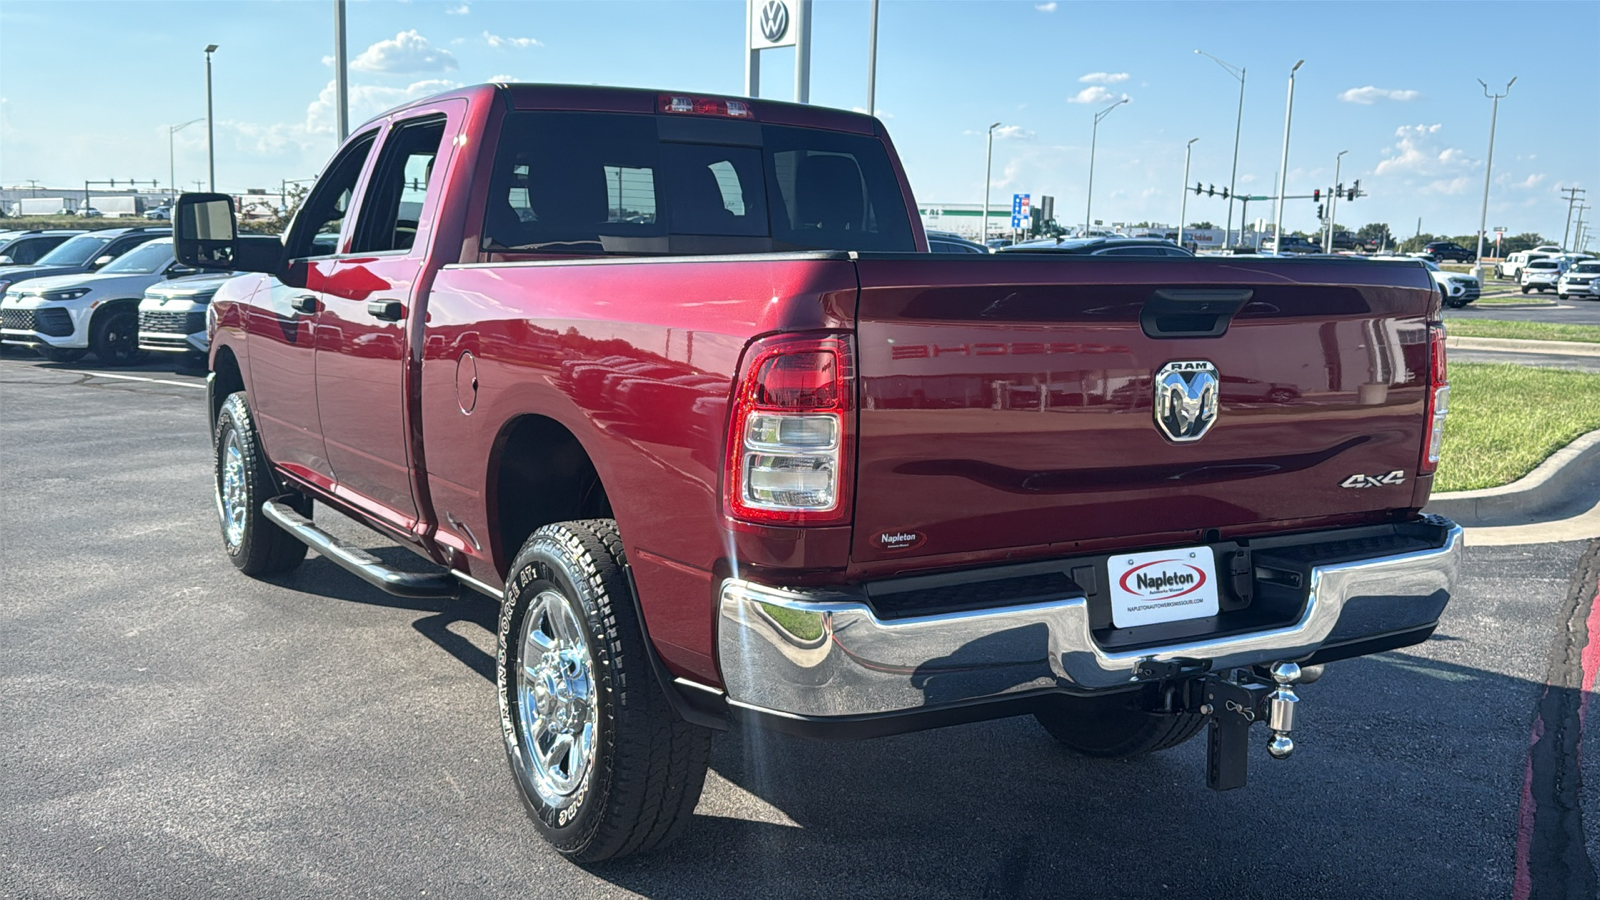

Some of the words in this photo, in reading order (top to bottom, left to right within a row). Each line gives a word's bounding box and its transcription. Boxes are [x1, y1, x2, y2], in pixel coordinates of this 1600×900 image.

[1171, 362, 1207, 370] RAM
[881, 532, 916, 543] Napleton
[1136, 570, 1194, 590] Napleton
